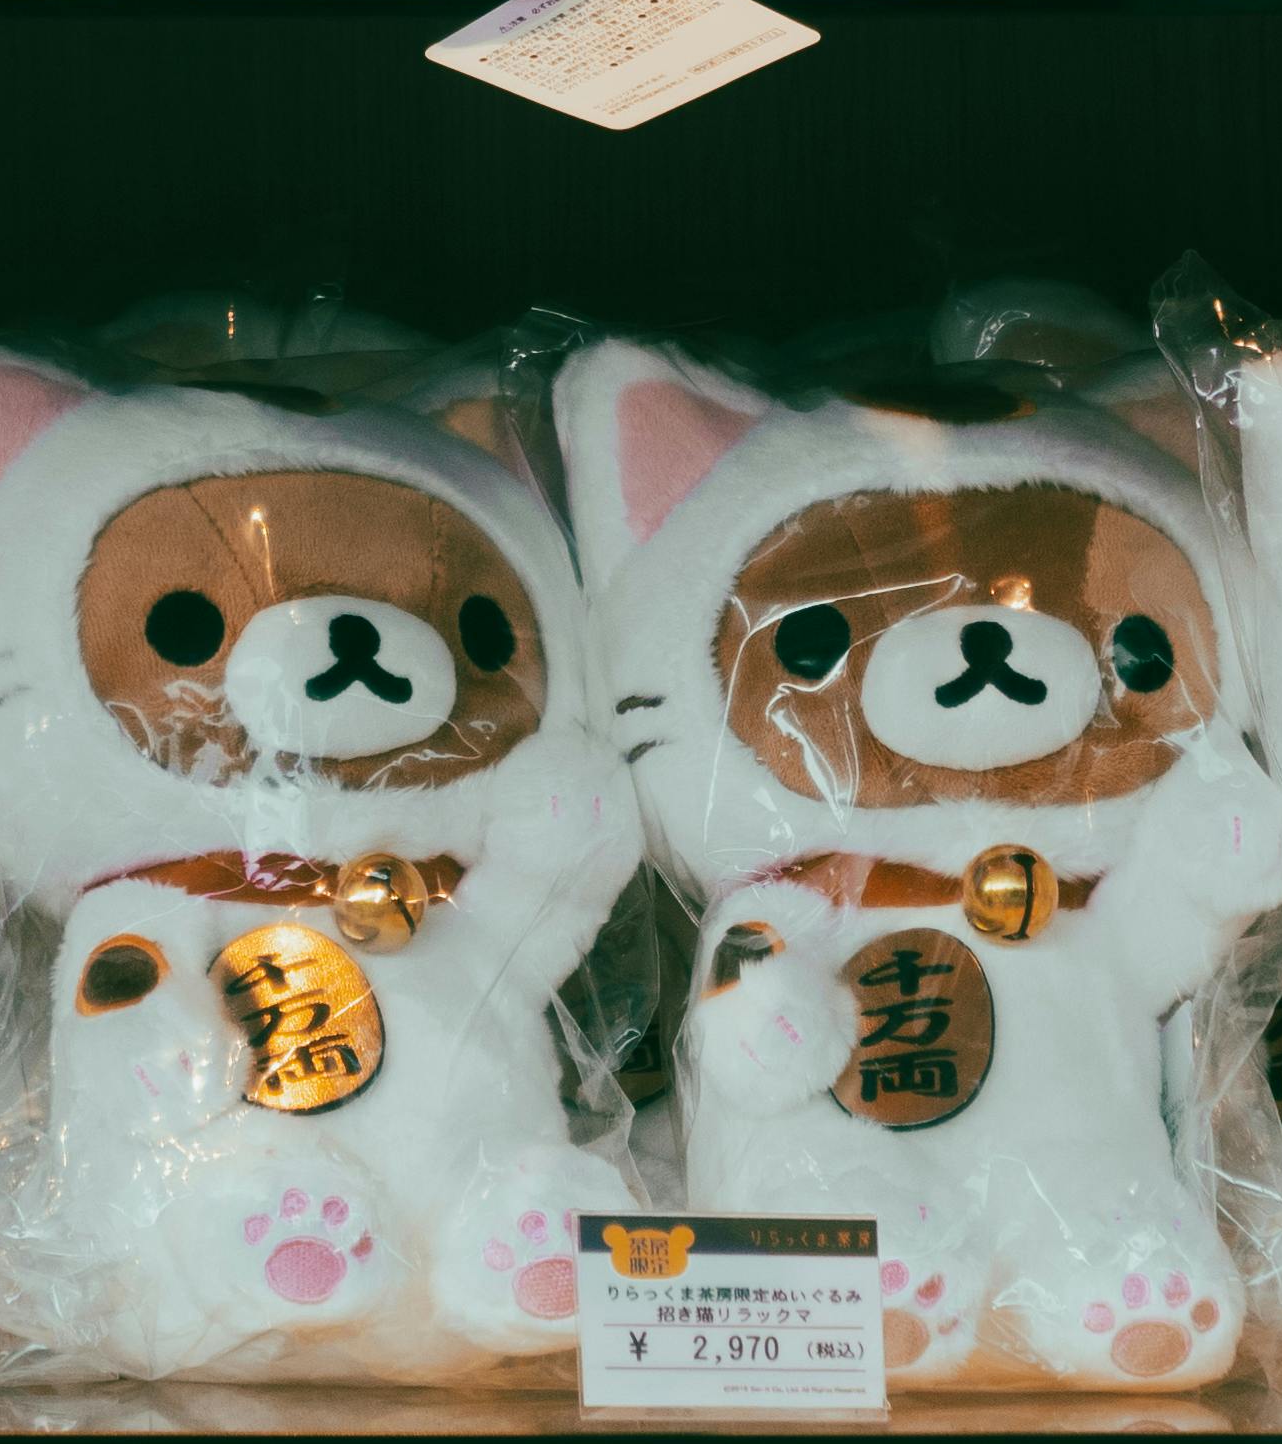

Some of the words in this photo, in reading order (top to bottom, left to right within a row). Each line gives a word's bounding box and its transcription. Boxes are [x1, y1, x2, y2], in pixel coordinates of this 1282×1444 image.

[225, 954, 362, 1096] 千万両
[858, 950, 959, 1102] 千万両
[607, 1285, 862, 1303] りらっくま茶房限定ぬいぐるみ
[658, 1306, 811, 1324] 招き猫リラックマ
[693, 1334, 779, 1364] 2,970
